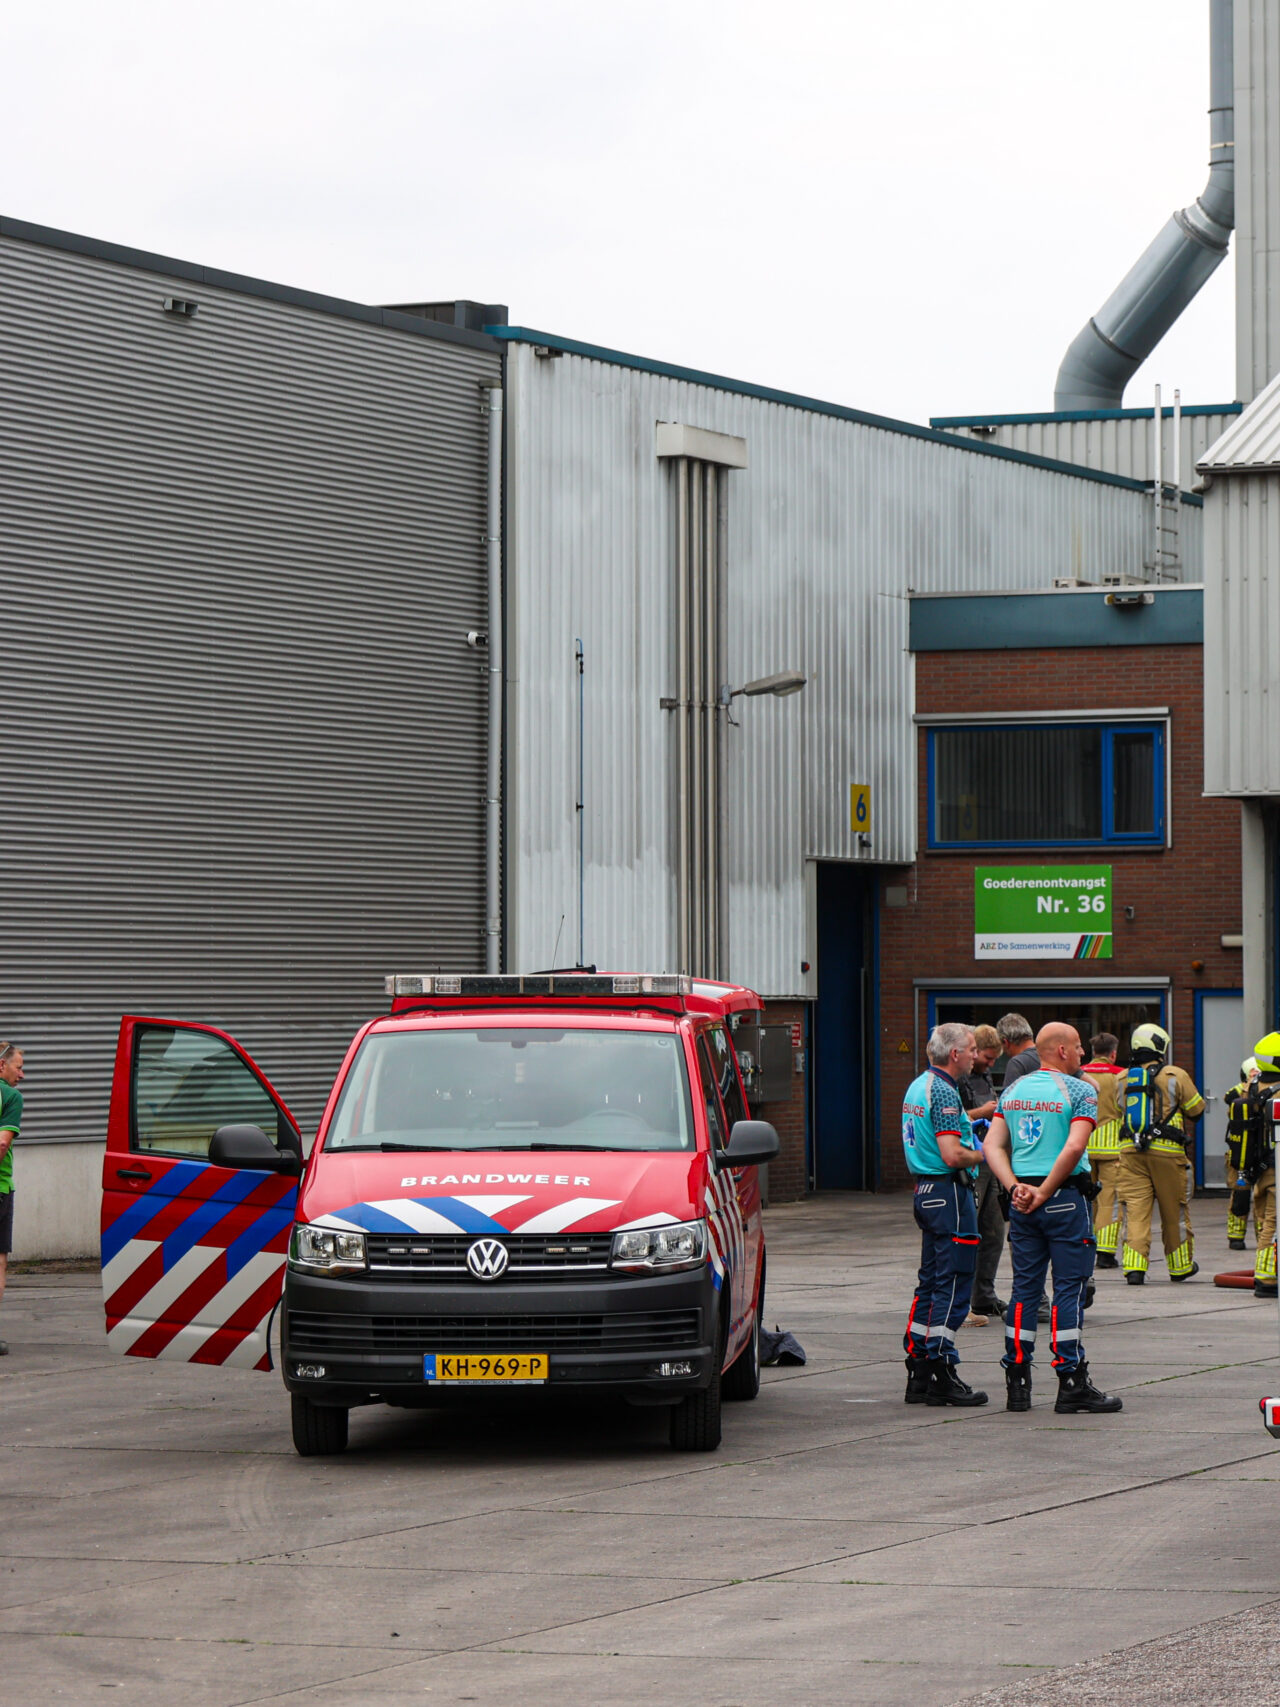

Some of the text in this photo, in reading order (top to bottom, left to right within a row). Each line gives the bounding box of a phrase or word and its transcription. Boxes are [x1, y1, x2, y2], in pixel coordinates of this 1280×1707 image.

[856, 793, 867, 823] 6
[983, 876, 1106, 891] Goederenontvangst
[1036, 894, 1106, 914] Nr. 36
[979, 941, 1071, 952] ABZ De Samenwerking
[1001, 1099, 1064, 1114] AMBULANCE
[400, 1173, 592, 1187] BRANDWEER
[441, 1357, 542, 1376] KH-969-P
